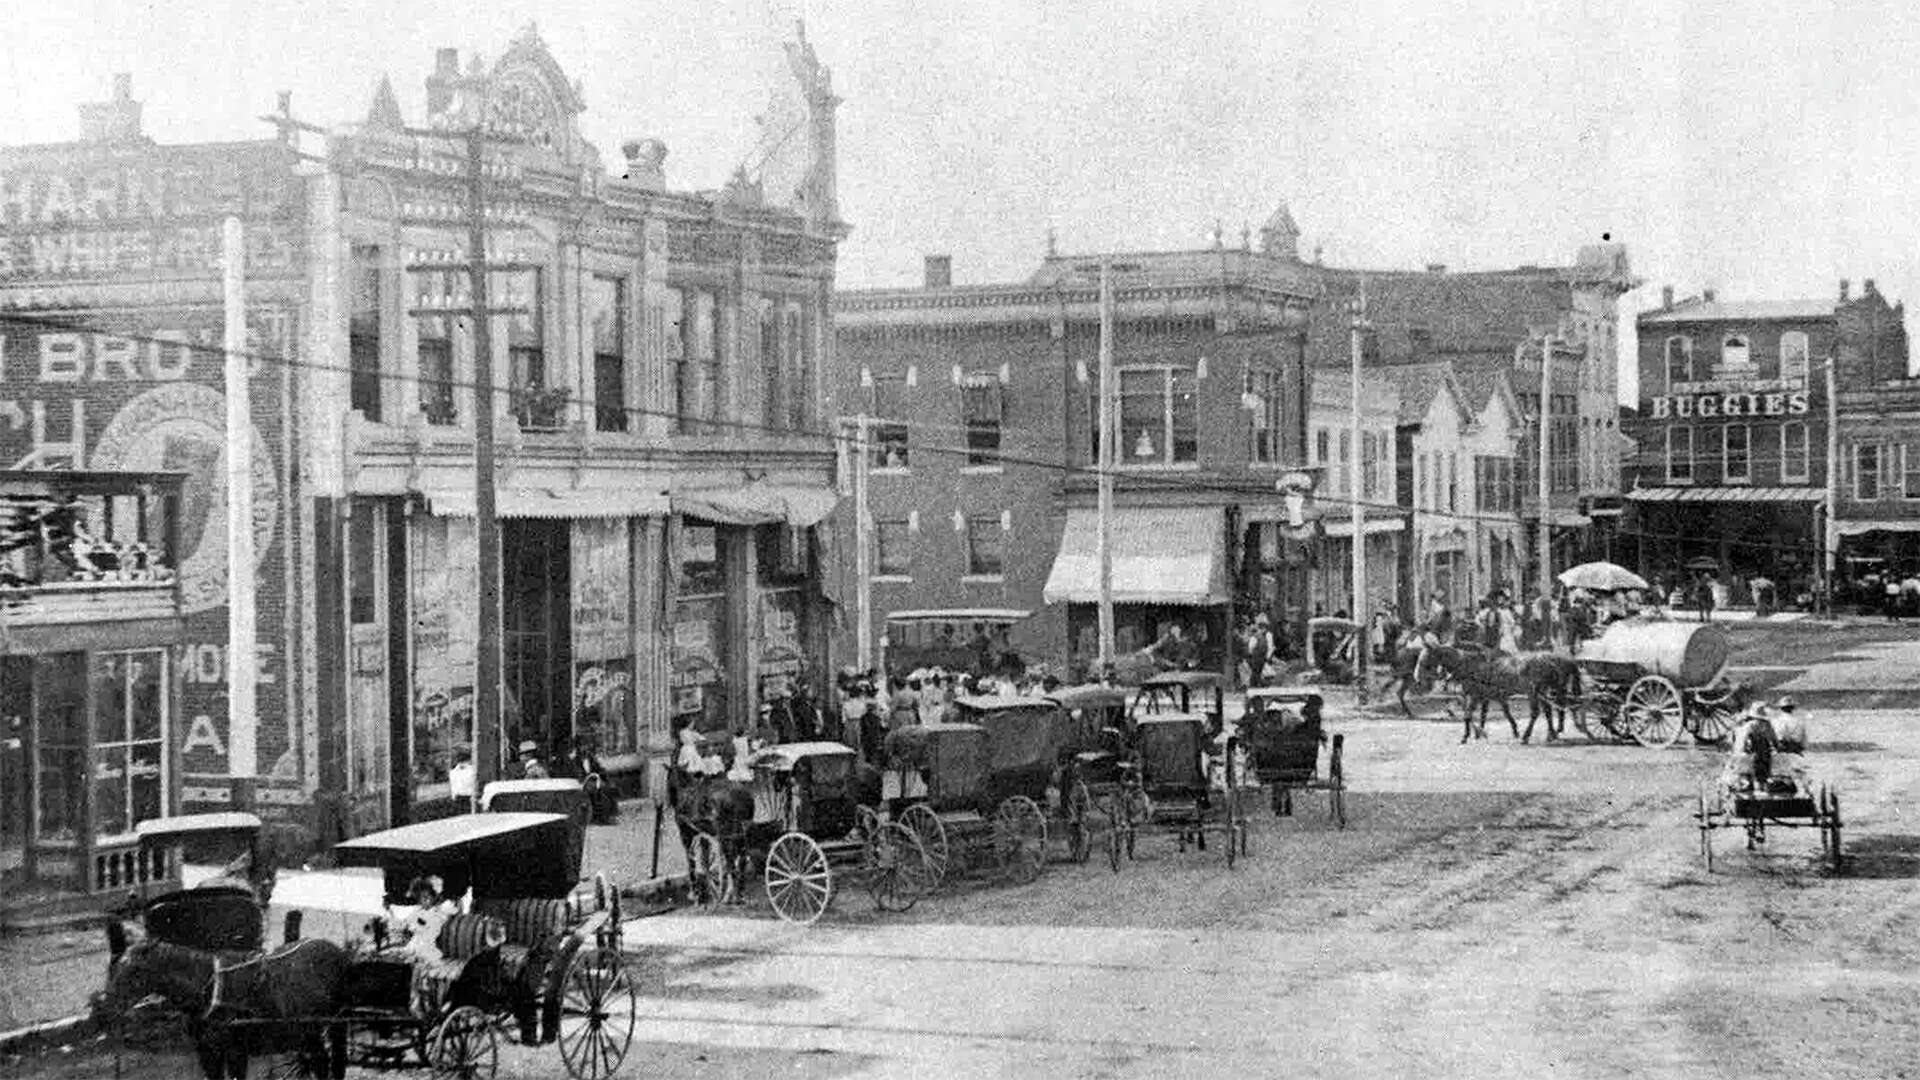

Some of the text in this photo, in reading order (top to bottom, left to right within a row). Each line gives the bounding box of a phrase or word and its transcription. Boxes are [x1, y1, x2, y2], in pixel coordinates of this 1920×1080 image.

[1650, 393, 1809, 420] BUGGIES
[175, 643, 277, 685] MOE
[181, 714, 226, 756] A
